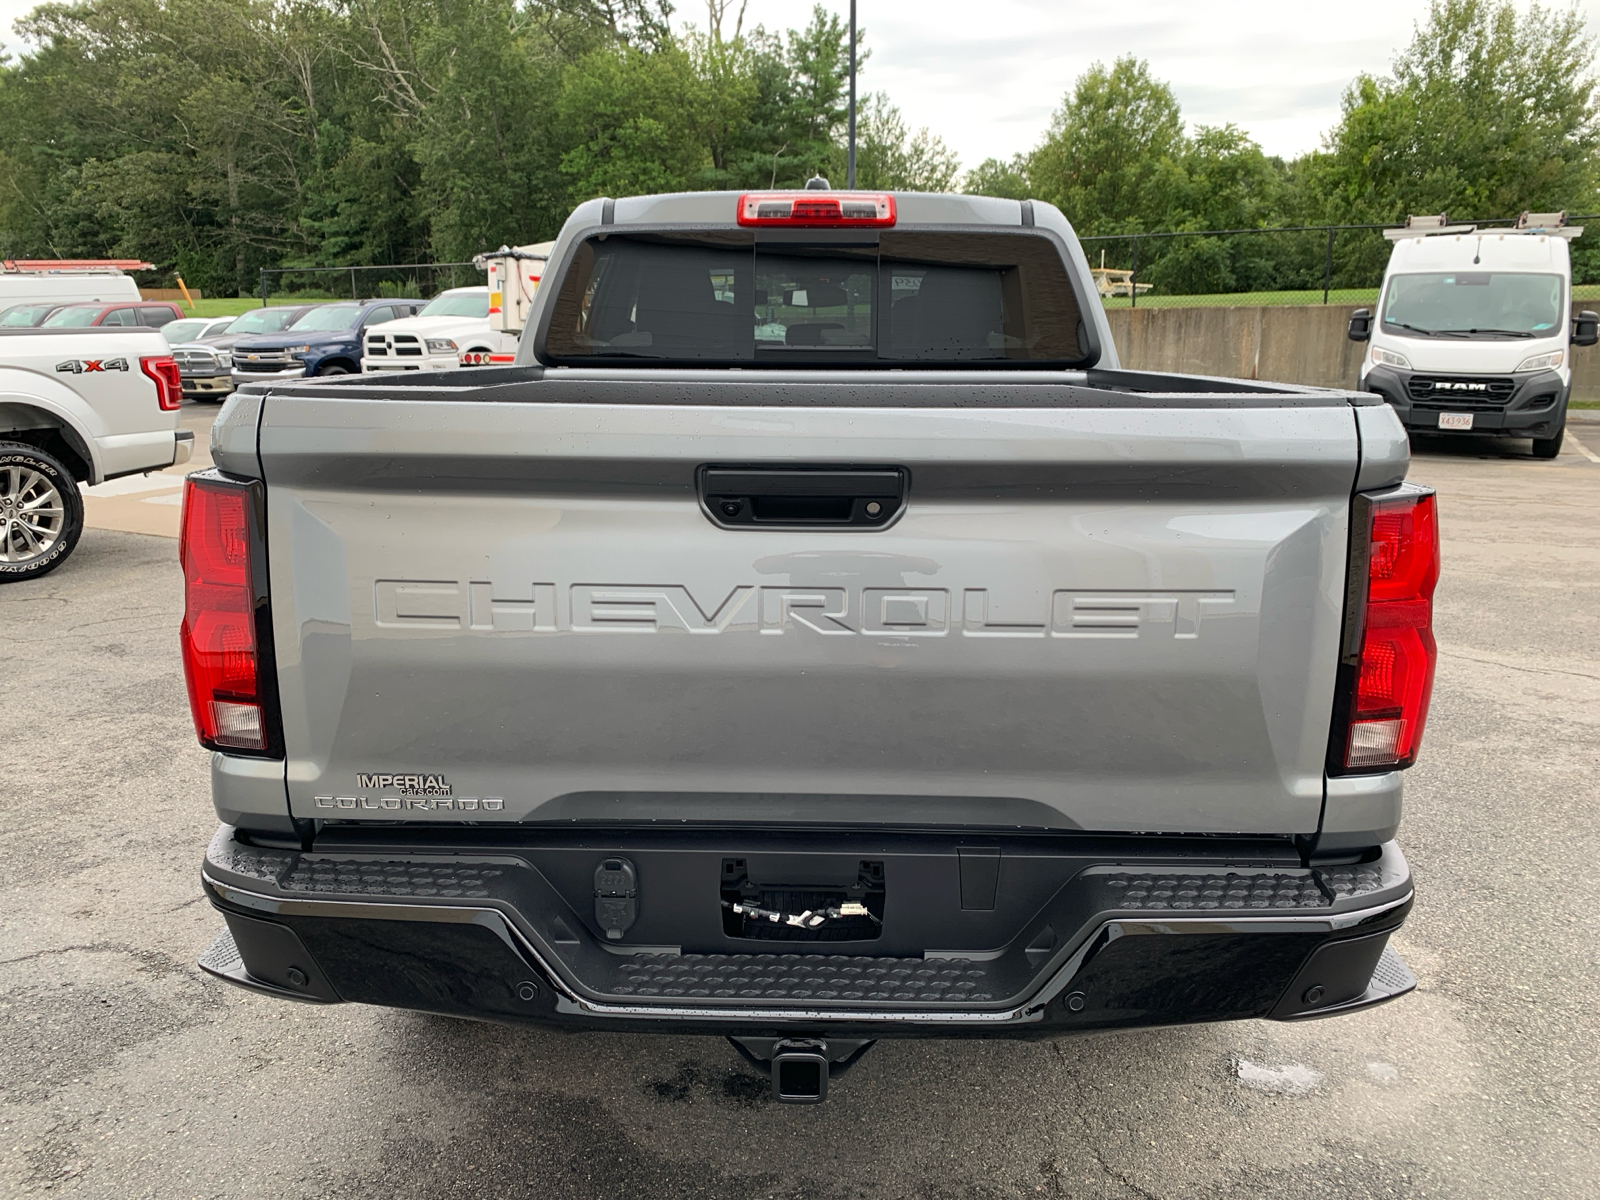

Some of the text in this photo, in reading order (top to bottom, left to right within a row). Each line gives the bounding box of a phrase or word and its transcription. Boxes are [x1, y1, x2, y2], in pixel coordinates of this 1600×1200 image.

[1435, 382, 1487, 391] RAM
[0, 455, 58, 476] NGLER
[374, 578, 1237, 640] CHEVROLET
[356, 772, 452, 789] IMPERIAL
[399, 787, 452, 796] cars.com
[314, 794, 506, 812] COLORADO
